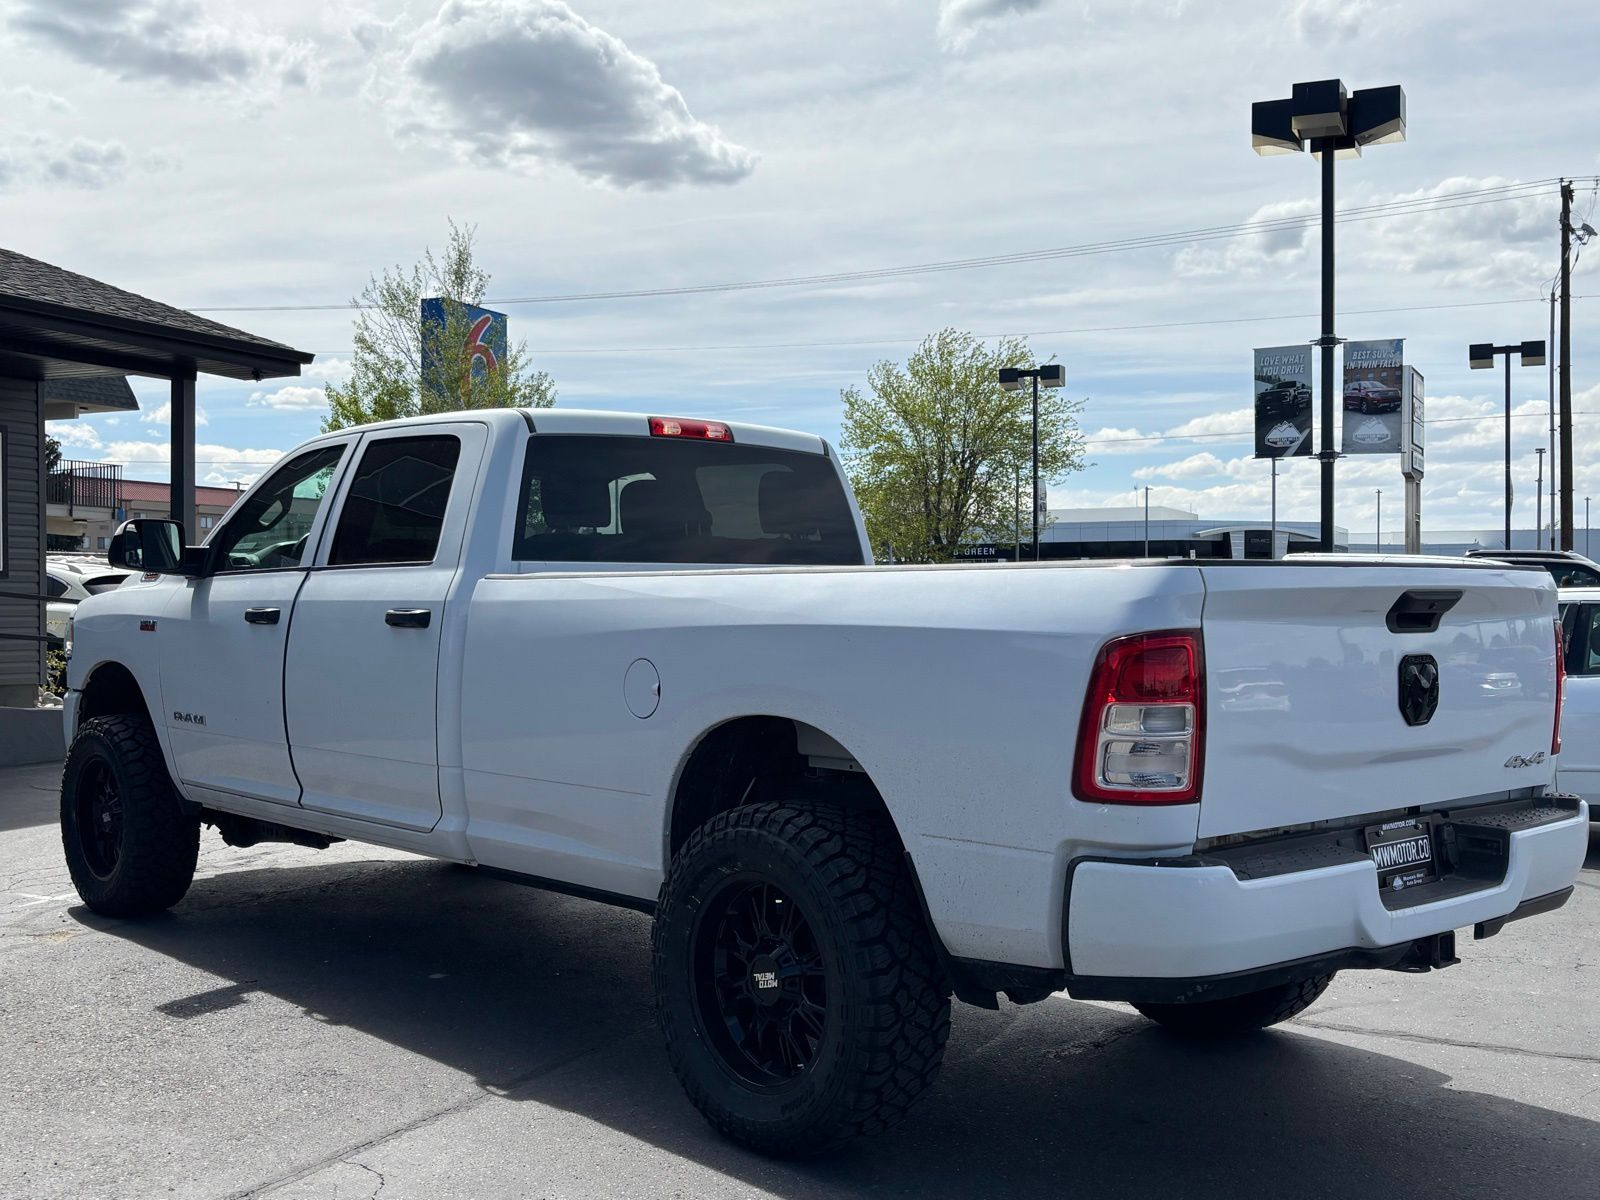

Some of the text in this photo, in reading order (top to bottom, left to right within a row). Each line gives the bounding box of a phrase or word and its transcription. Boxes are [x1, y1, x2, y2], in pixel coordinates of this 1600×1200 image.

[1260, 354, 1304, 366] LOVE WHAT
[1352, 351, 1371, 360] BEST
[459, 313, 500, 410] 6
[1346, 359, 1401, 370] IN TWIN FALLS
[1263, 364, 1304, 376] YOU DRIVE
[964, 547, 995, 556] GREEN
[173, 711, 207, 726] RAM
[753, 971, 775, 982] METAL
[758, 979, 778, 989] MOTO
